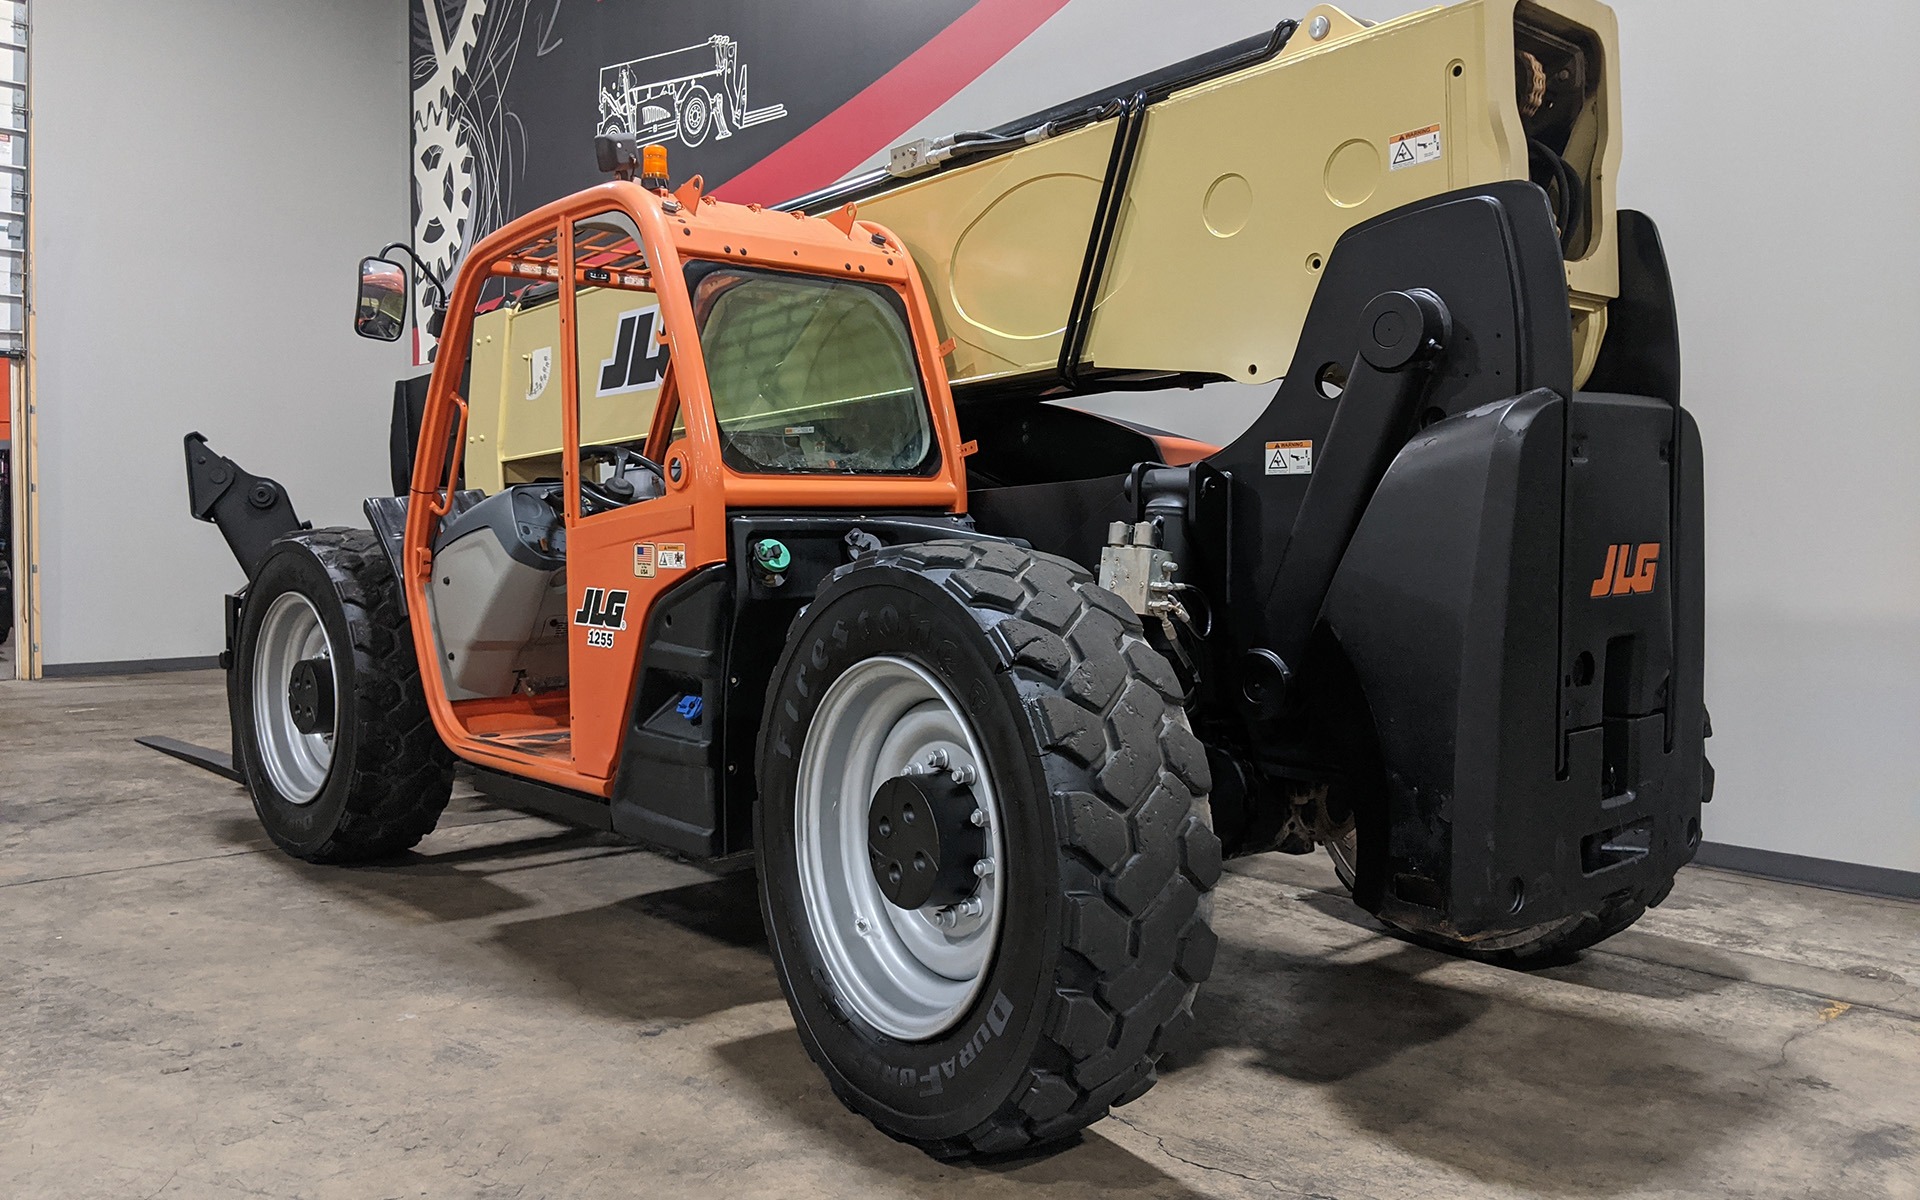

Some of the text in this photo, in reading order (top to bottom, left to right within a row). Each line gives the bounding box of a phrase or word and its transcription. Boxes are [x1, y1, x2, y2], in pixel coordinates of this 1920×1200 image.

[1405, 127, 1431, 139] WARNING
[600, 311, 671, 391] JL
[1590, 543, 1661, 597] JLG
[575, 588, 629, 629] JLG
[588, 631, 613, 647] 1255
